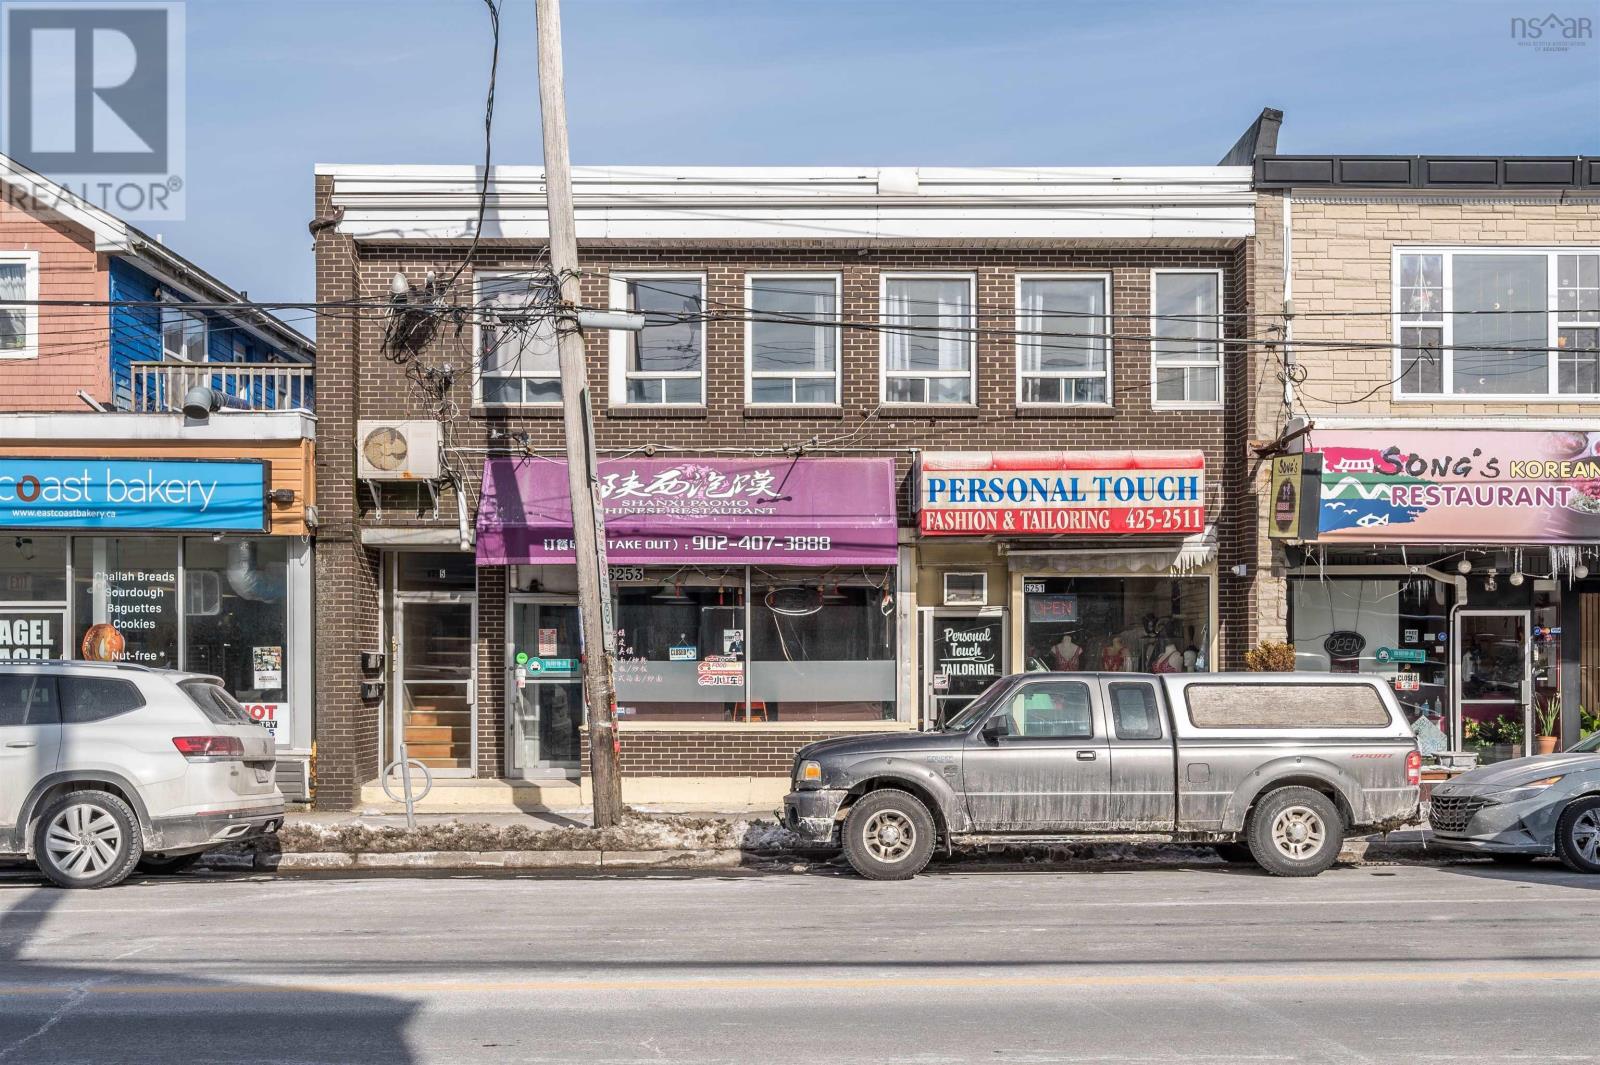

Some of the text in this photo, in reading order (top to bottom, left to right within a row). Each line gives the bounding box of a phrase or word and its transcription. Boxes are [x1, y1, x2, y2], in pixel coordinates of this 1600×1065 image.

[1509, 460, 1600, 479] KOREAN
[0, 468, 217, 512] coast bakery
[927, 476, 1199, 503] PERSONAL TOUCH
[1390, 486, 1571, 506] RESTAURANT
[12, 509, 116, 519] www.eastcoastbakery.ca
[604, 507, 777, 515] HINESE RESTAURANT
[925, 508, 1201, 530] FASHION & TAILORING 425-2511
[607, 540, 642, 550] TAKE
[692, 536, 831, 551] 902-407-3888
[94, 571, 176, 582] Challah Breads
[608, 568, 643, 581] 6253
[105, 587, 164, 599] Sourdough
[1024, 584, 1045, 593] 6251
[107, 604, 162, 615] Baguettes
[1035, 600, 1073, 616] OPEN
[113, 619, 156, 629] Cookies
[943, 628, 992, 643] Personal
[950, 643, 982, 657] Touch
[1328, 638, 1361, 651] OPEN
[111, 651, 157, 660] Nut-free
[941, 664, 995, 676] TAILORING
